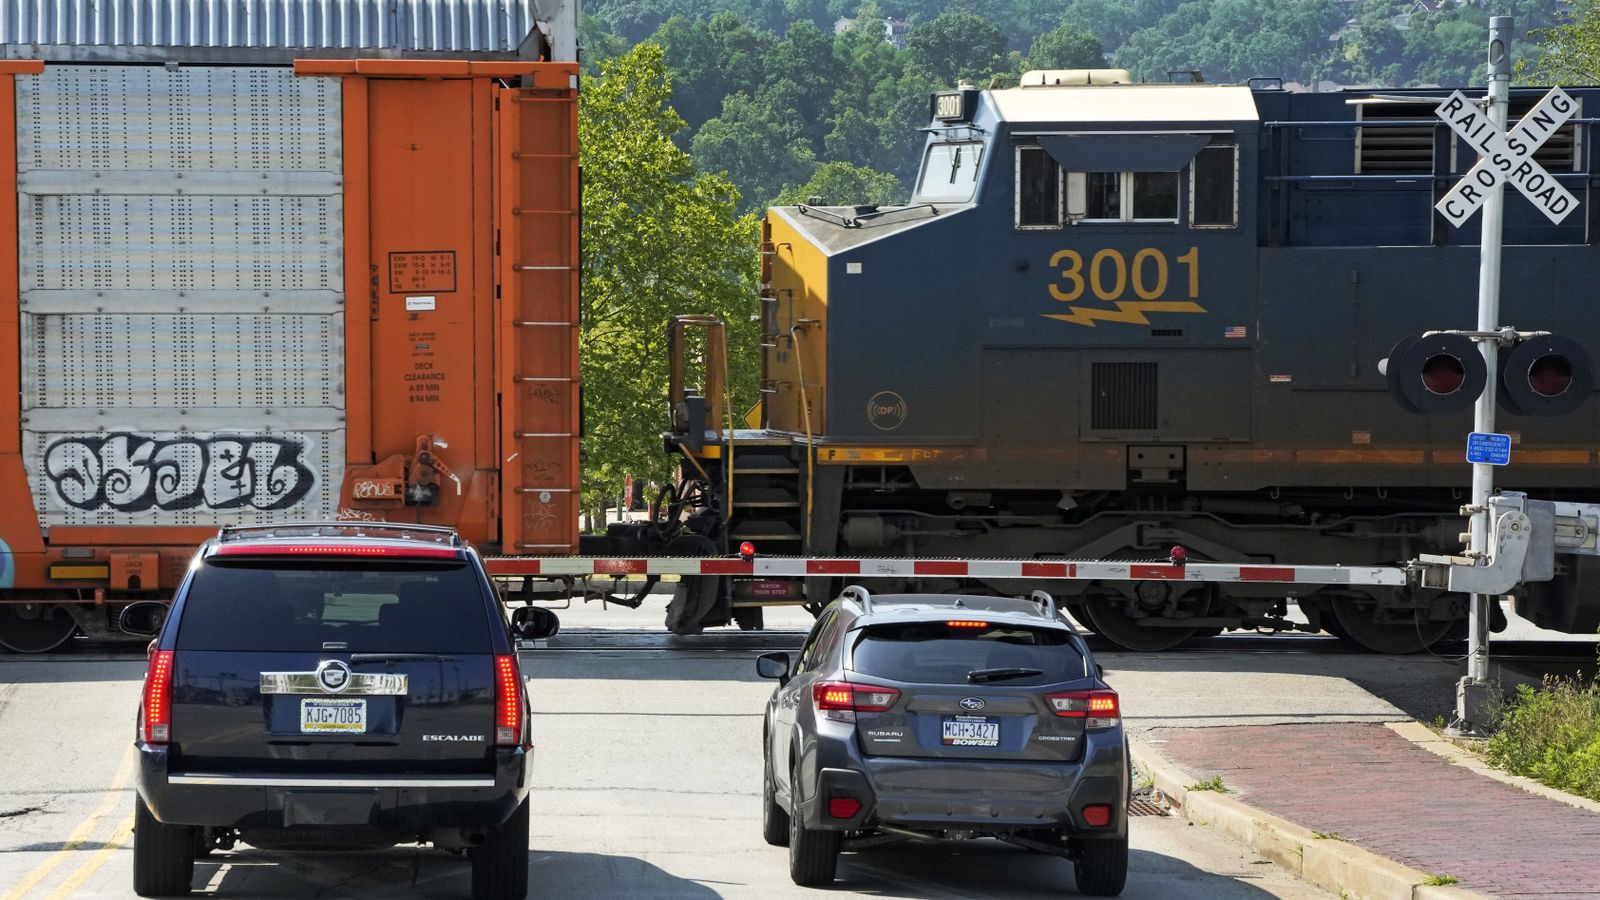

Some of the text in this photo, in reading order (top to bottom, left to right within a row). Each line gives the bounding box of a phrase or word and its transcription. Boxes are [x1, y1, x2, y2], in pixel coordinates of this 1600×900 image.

[938, 96, 960, 116] 3001
[1442, 96, 1569, 215] RAIL ROAD
[1445, 95, 1571, 219] CROSSING
[1048, 247, 1199, 301] 3001
[415, 362, 433, 370] DECK
[404, 373, 446, 381] CLEARANCE
[828, 450, 836, 460] F
